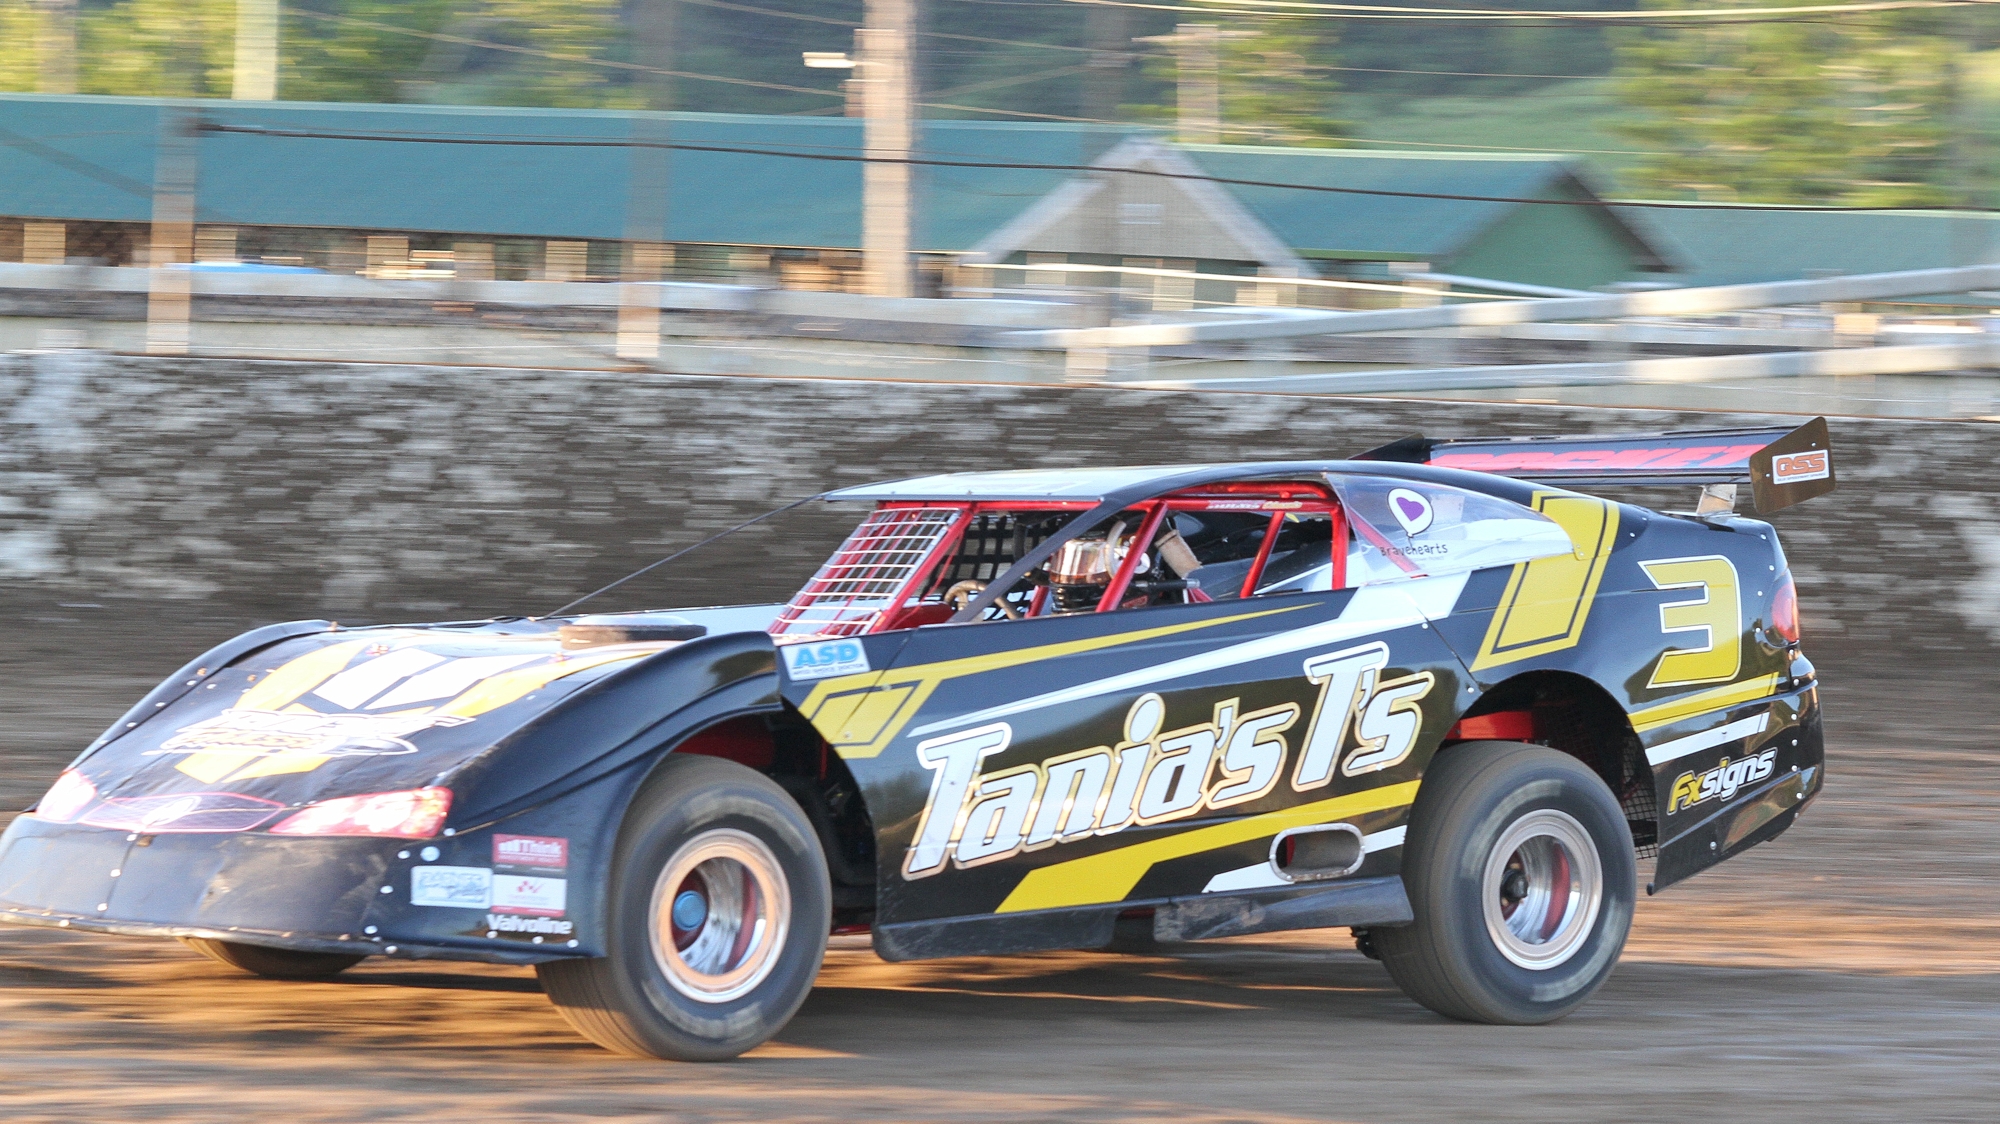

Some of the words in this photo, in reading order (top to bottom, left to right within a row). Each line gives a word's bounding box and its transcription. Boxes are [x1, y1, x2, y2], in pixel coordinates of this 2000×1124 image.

[1776, 453, 1826, 477] QSS
[1380, 543, 1448, 556] Bravehearts
[1637, 554, 1742, 690] 3
[792, 643, 860, 669] ASD
[900, 693, 1300, 881] Tania's
[1293, 640, 1435, 792] T's
[486, 914, 573, 934] Valvoline
